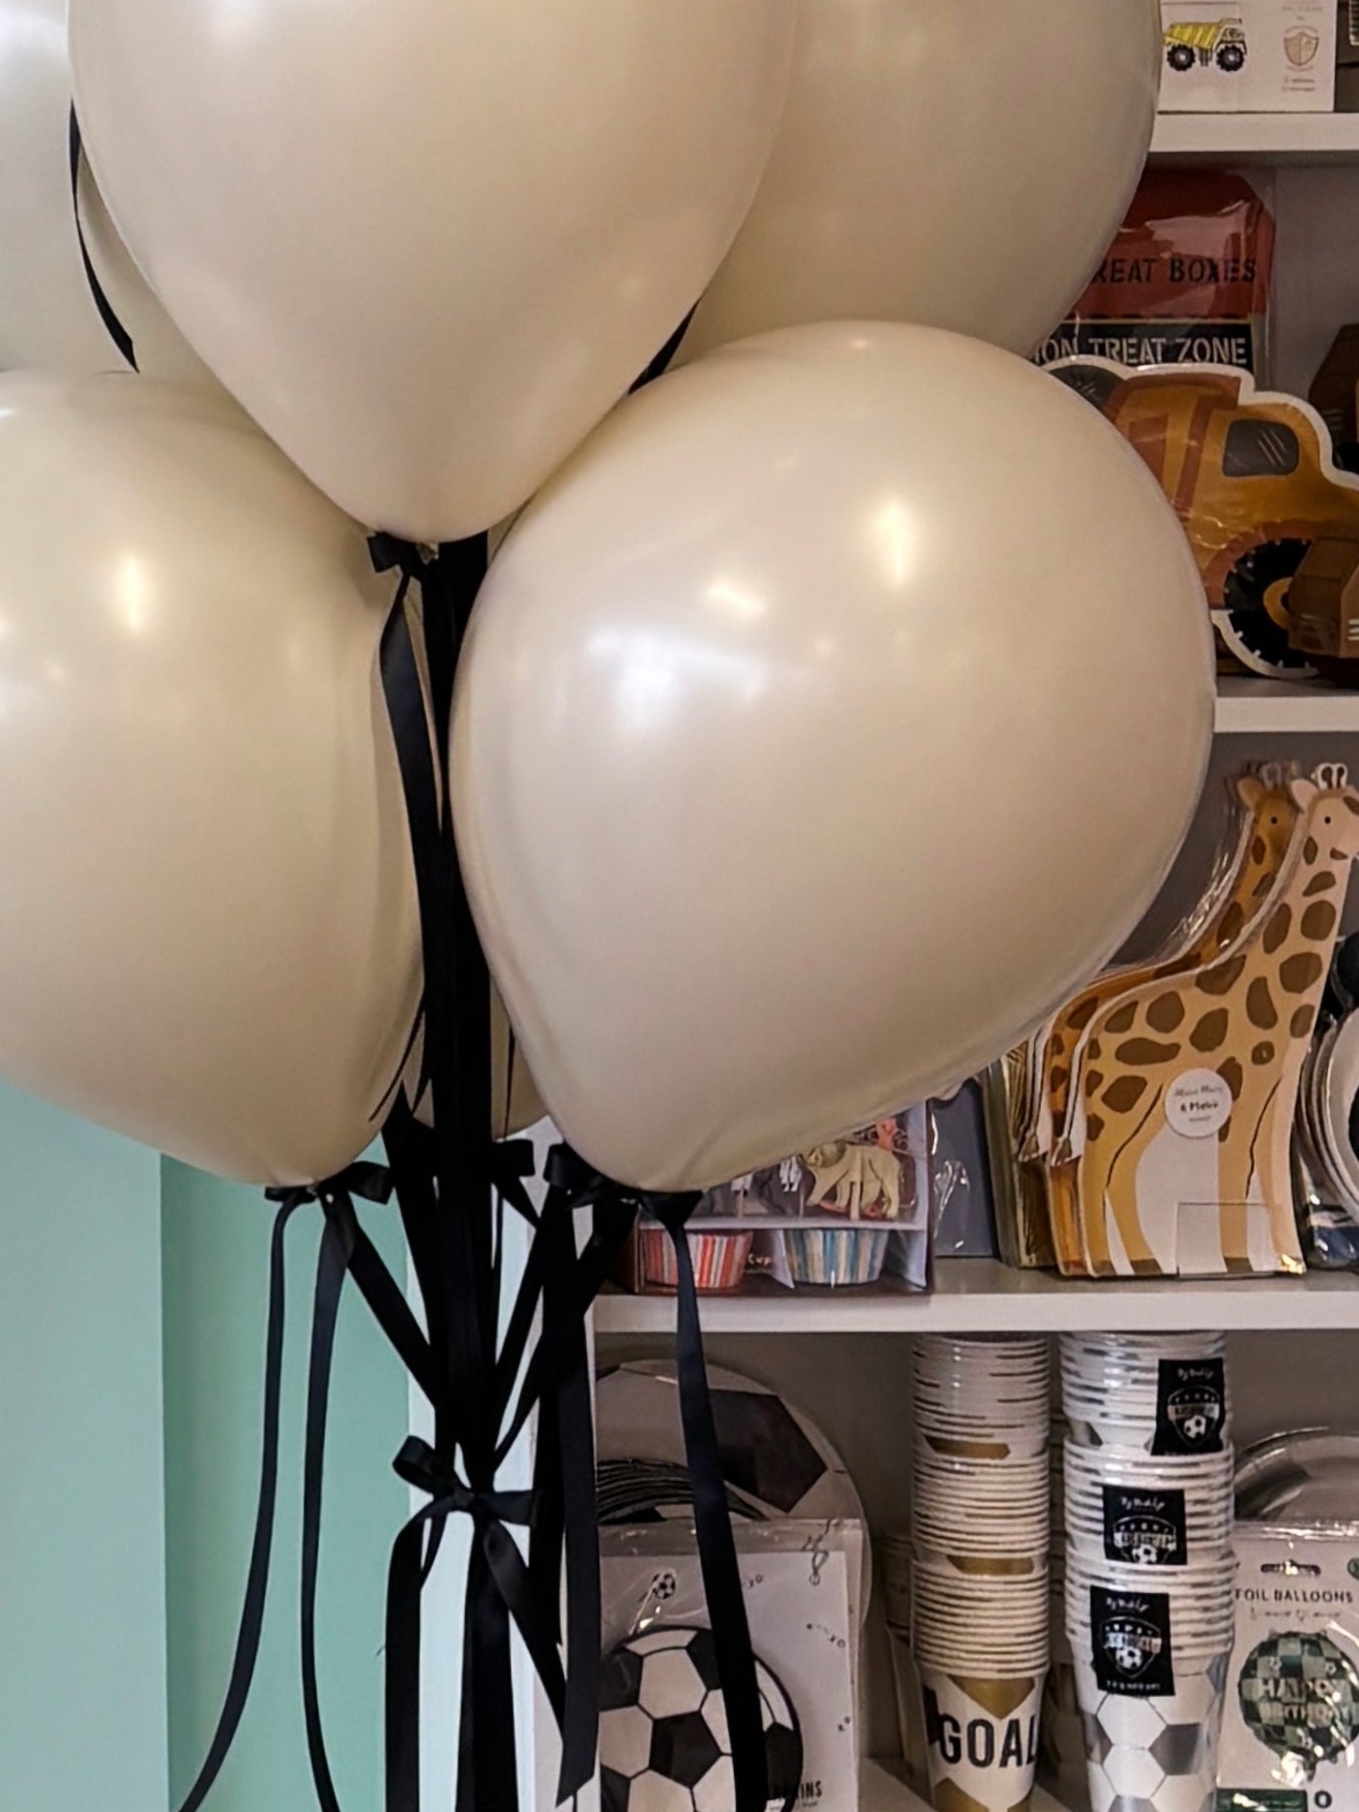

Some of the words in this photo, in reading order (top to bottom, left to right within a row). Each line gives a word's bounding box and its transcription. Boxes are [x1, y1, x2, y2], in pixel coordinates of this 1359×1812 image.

[1169, 257, 1255, 283] BOXES
[1089, 337, 1166, 364] TREAT
[1174, 337, 1247, 364] ZONE
[1235, 1588, 1268, 1602] FOIL
[1274, 1589, 1353, 1604] BALLOONS
